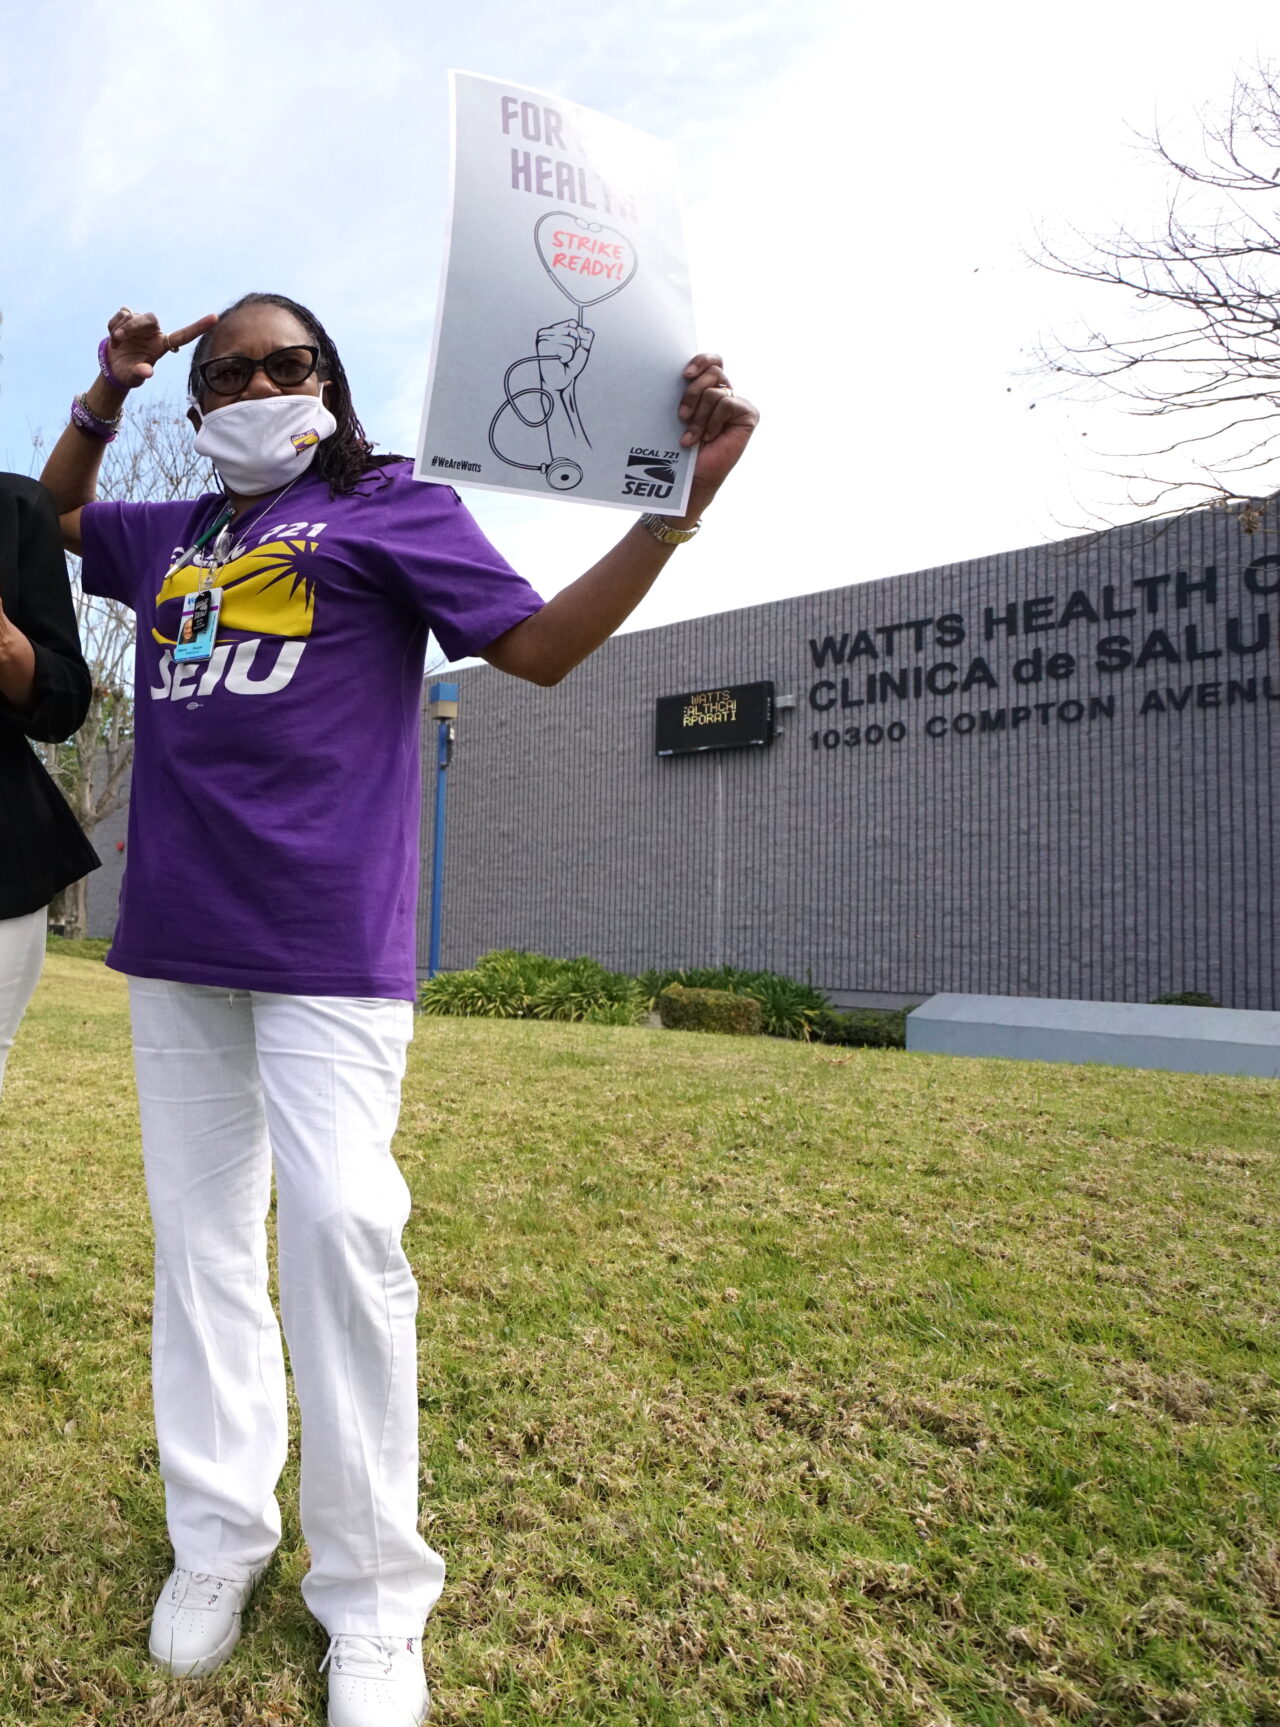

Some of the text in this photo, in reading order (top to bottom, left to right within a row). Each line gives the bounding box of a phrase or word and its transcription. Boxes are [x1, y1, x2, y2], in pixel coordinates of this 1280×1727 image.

[501, 95, 567, 151] FOR
[551, 230, 625, 260] STRIKE
[551, 252, 624, 281] READY!
[431, 455, 482, 473] #WeAreWatts
[630, 447, 680, 460] LOCAL 721
[622, 481, 673, 499] SEIU
[809, 613, 966, 659] WATTS
[983, 565, 1218, 642] HEALTH
[150, 639, 308, 701] SEIU
[809, 612, 1270, 711] CLINICA de SALU
[691, 690, 730, 705] WATTS
[810, 722, 906, 750] 10300
[925, 694, 1115, 738] COMPTON
